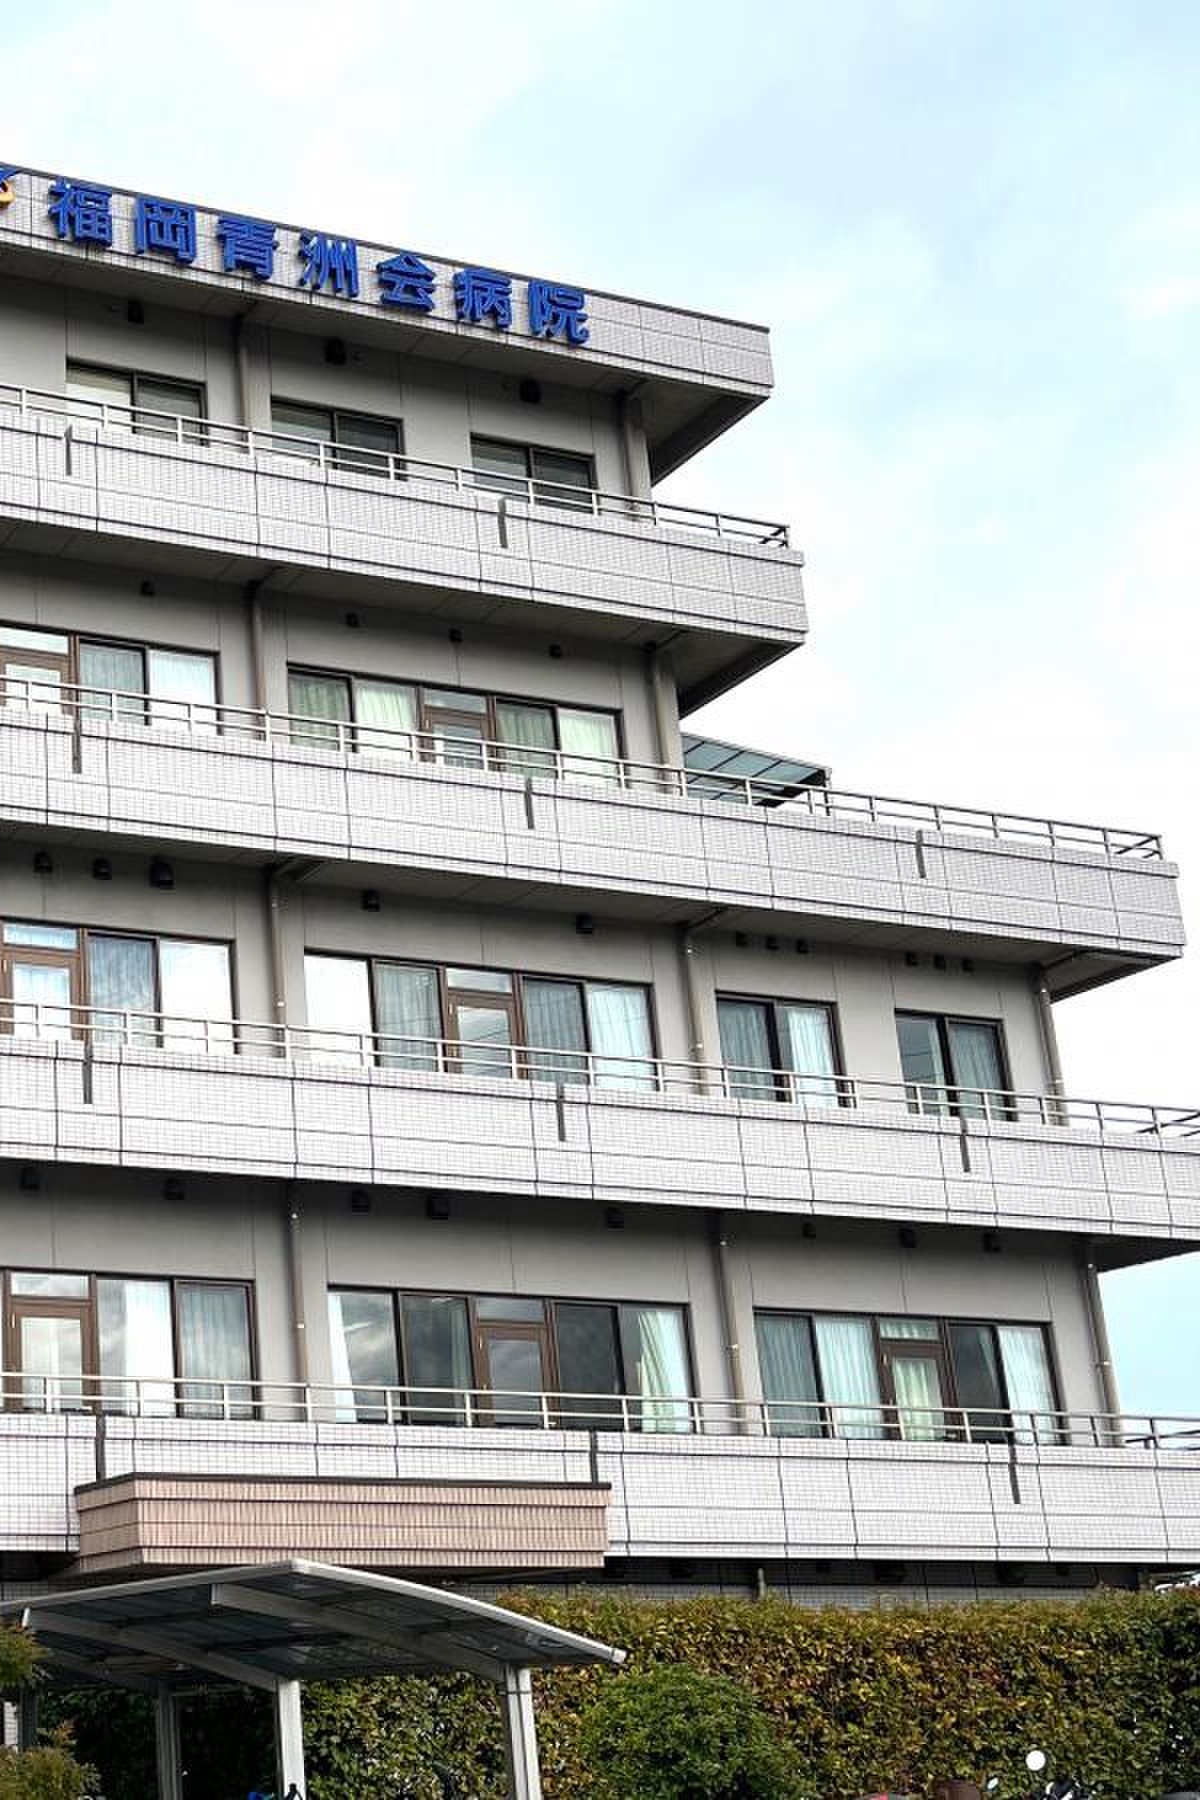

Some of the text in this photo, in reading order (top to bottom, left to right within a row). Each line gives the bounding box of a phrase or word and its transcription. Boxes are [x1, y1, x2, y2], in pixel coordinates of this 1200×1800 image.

[48, 178, 589, 344] 福岡青洲会病院
